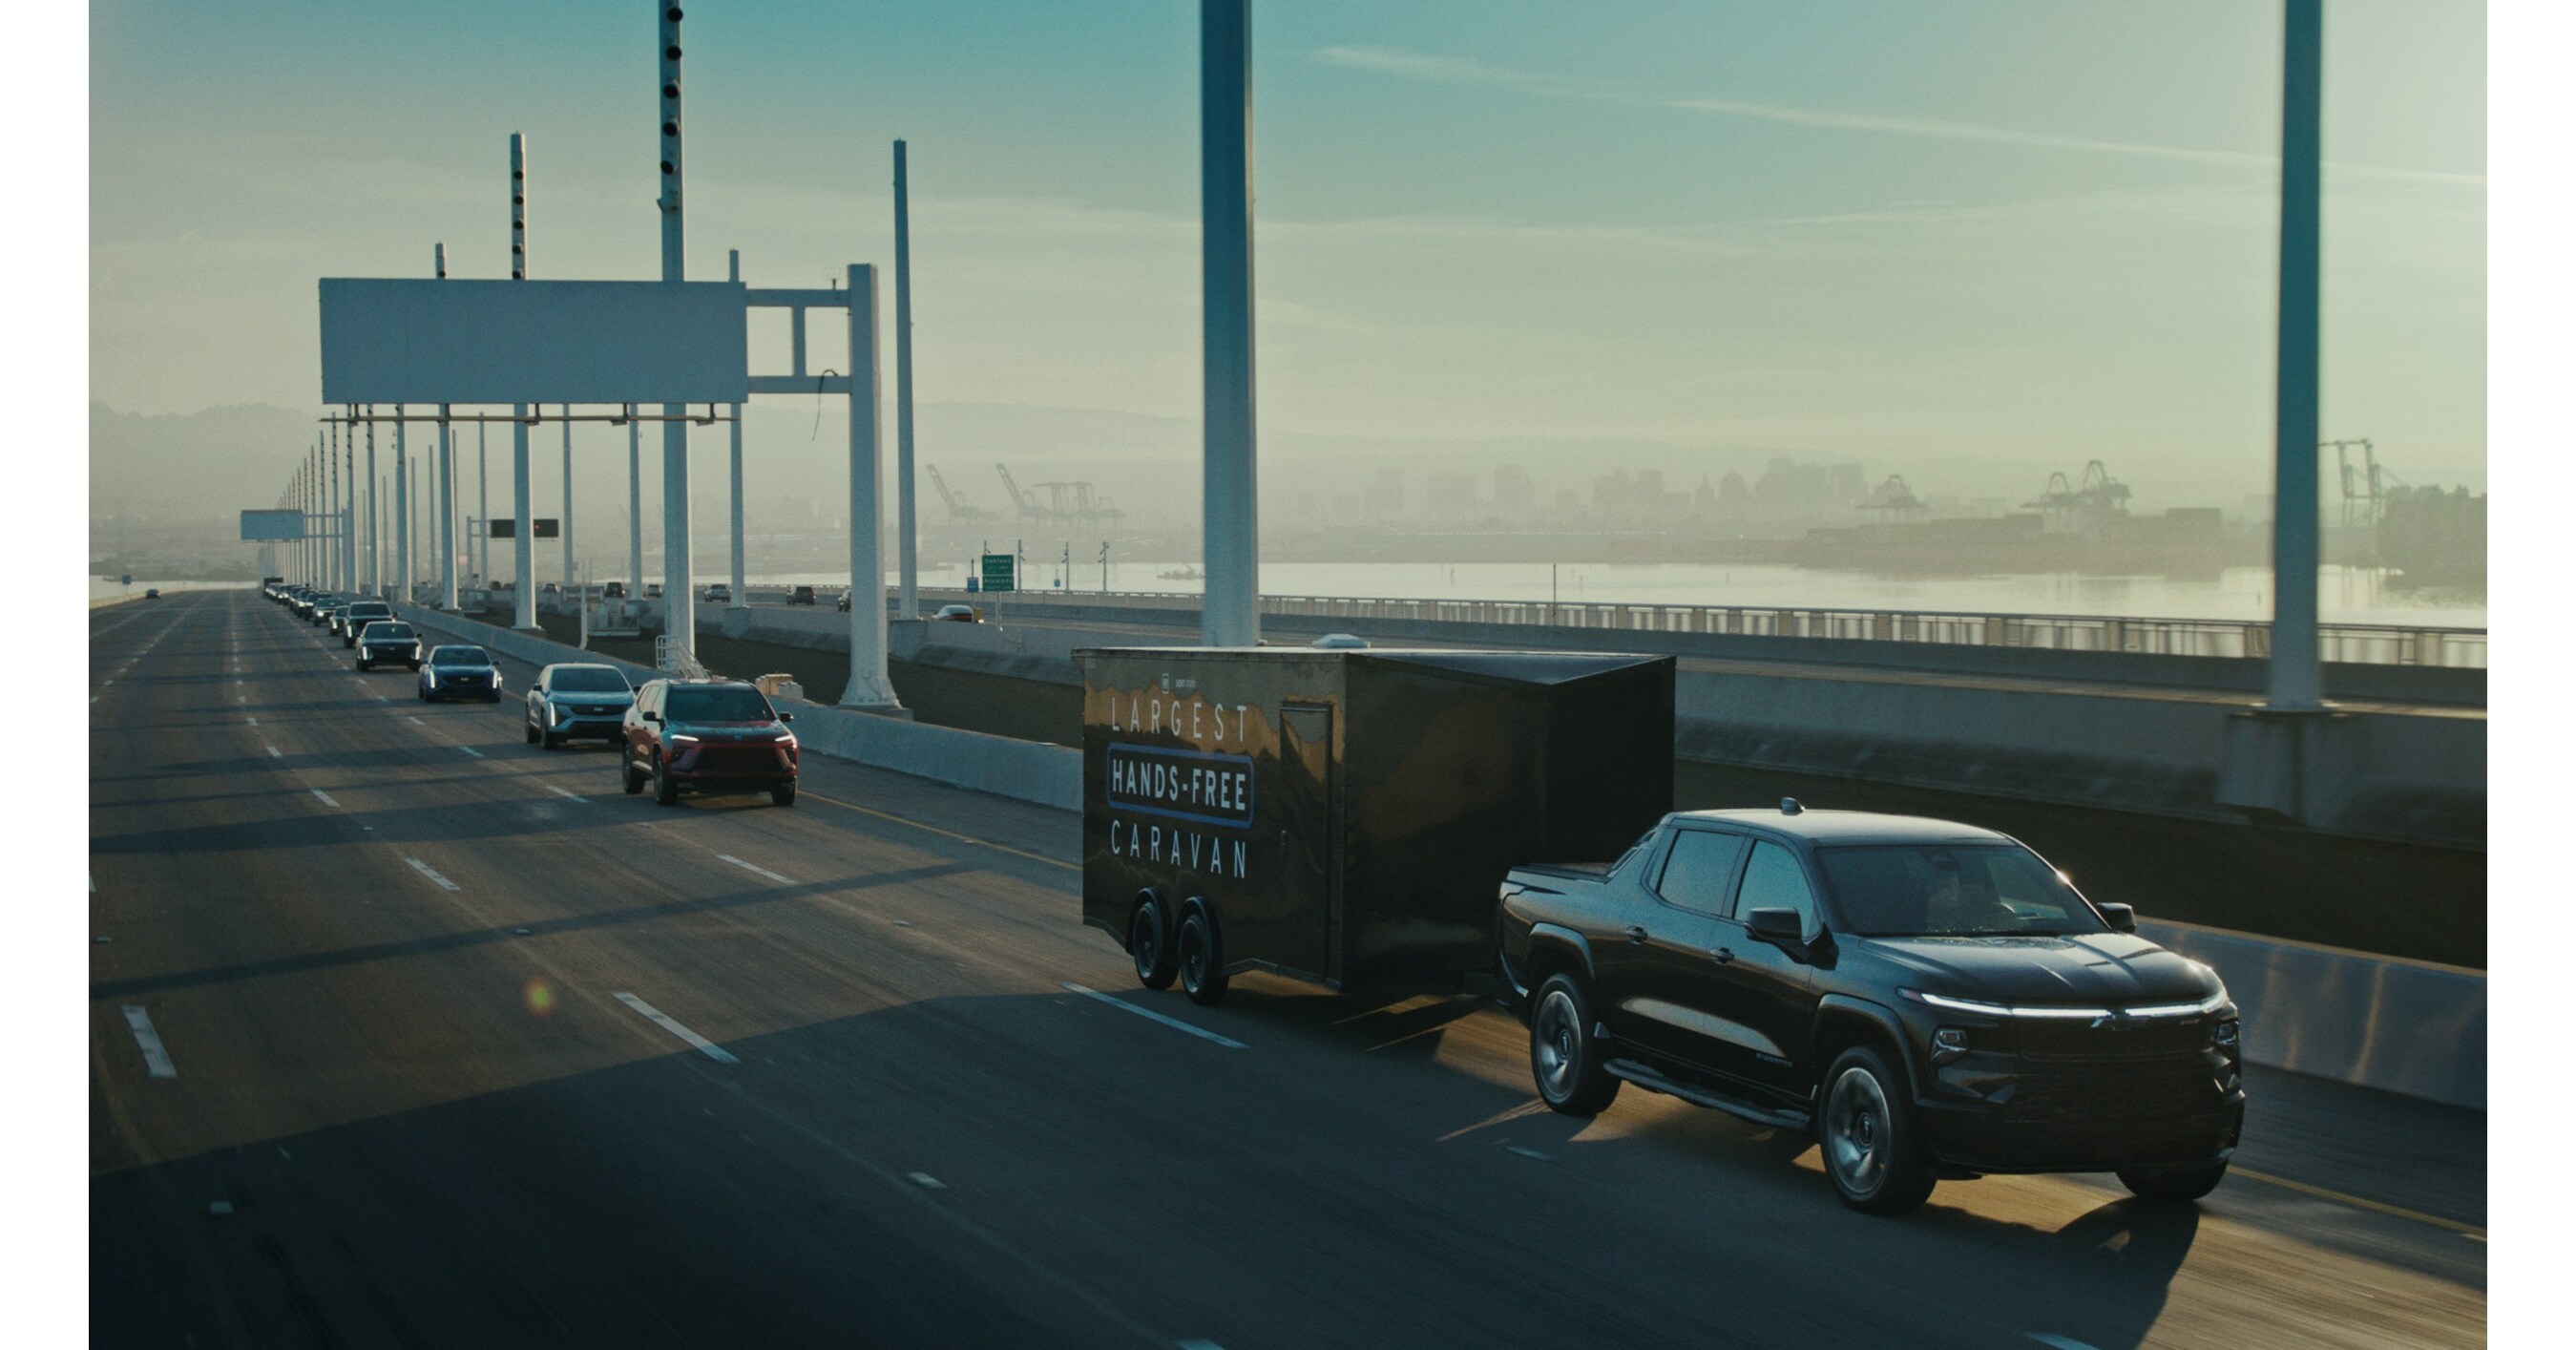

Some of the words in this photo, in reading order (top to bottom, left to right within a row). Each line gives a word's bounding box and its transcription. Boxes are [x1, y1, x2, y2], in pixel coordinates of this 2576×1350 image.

[1112, 697, 1246, 742] LARGEST
[1112, 758, 1246, 811] HANDS-FREE
[1111, 819, 1246, 878] CARAVAN
